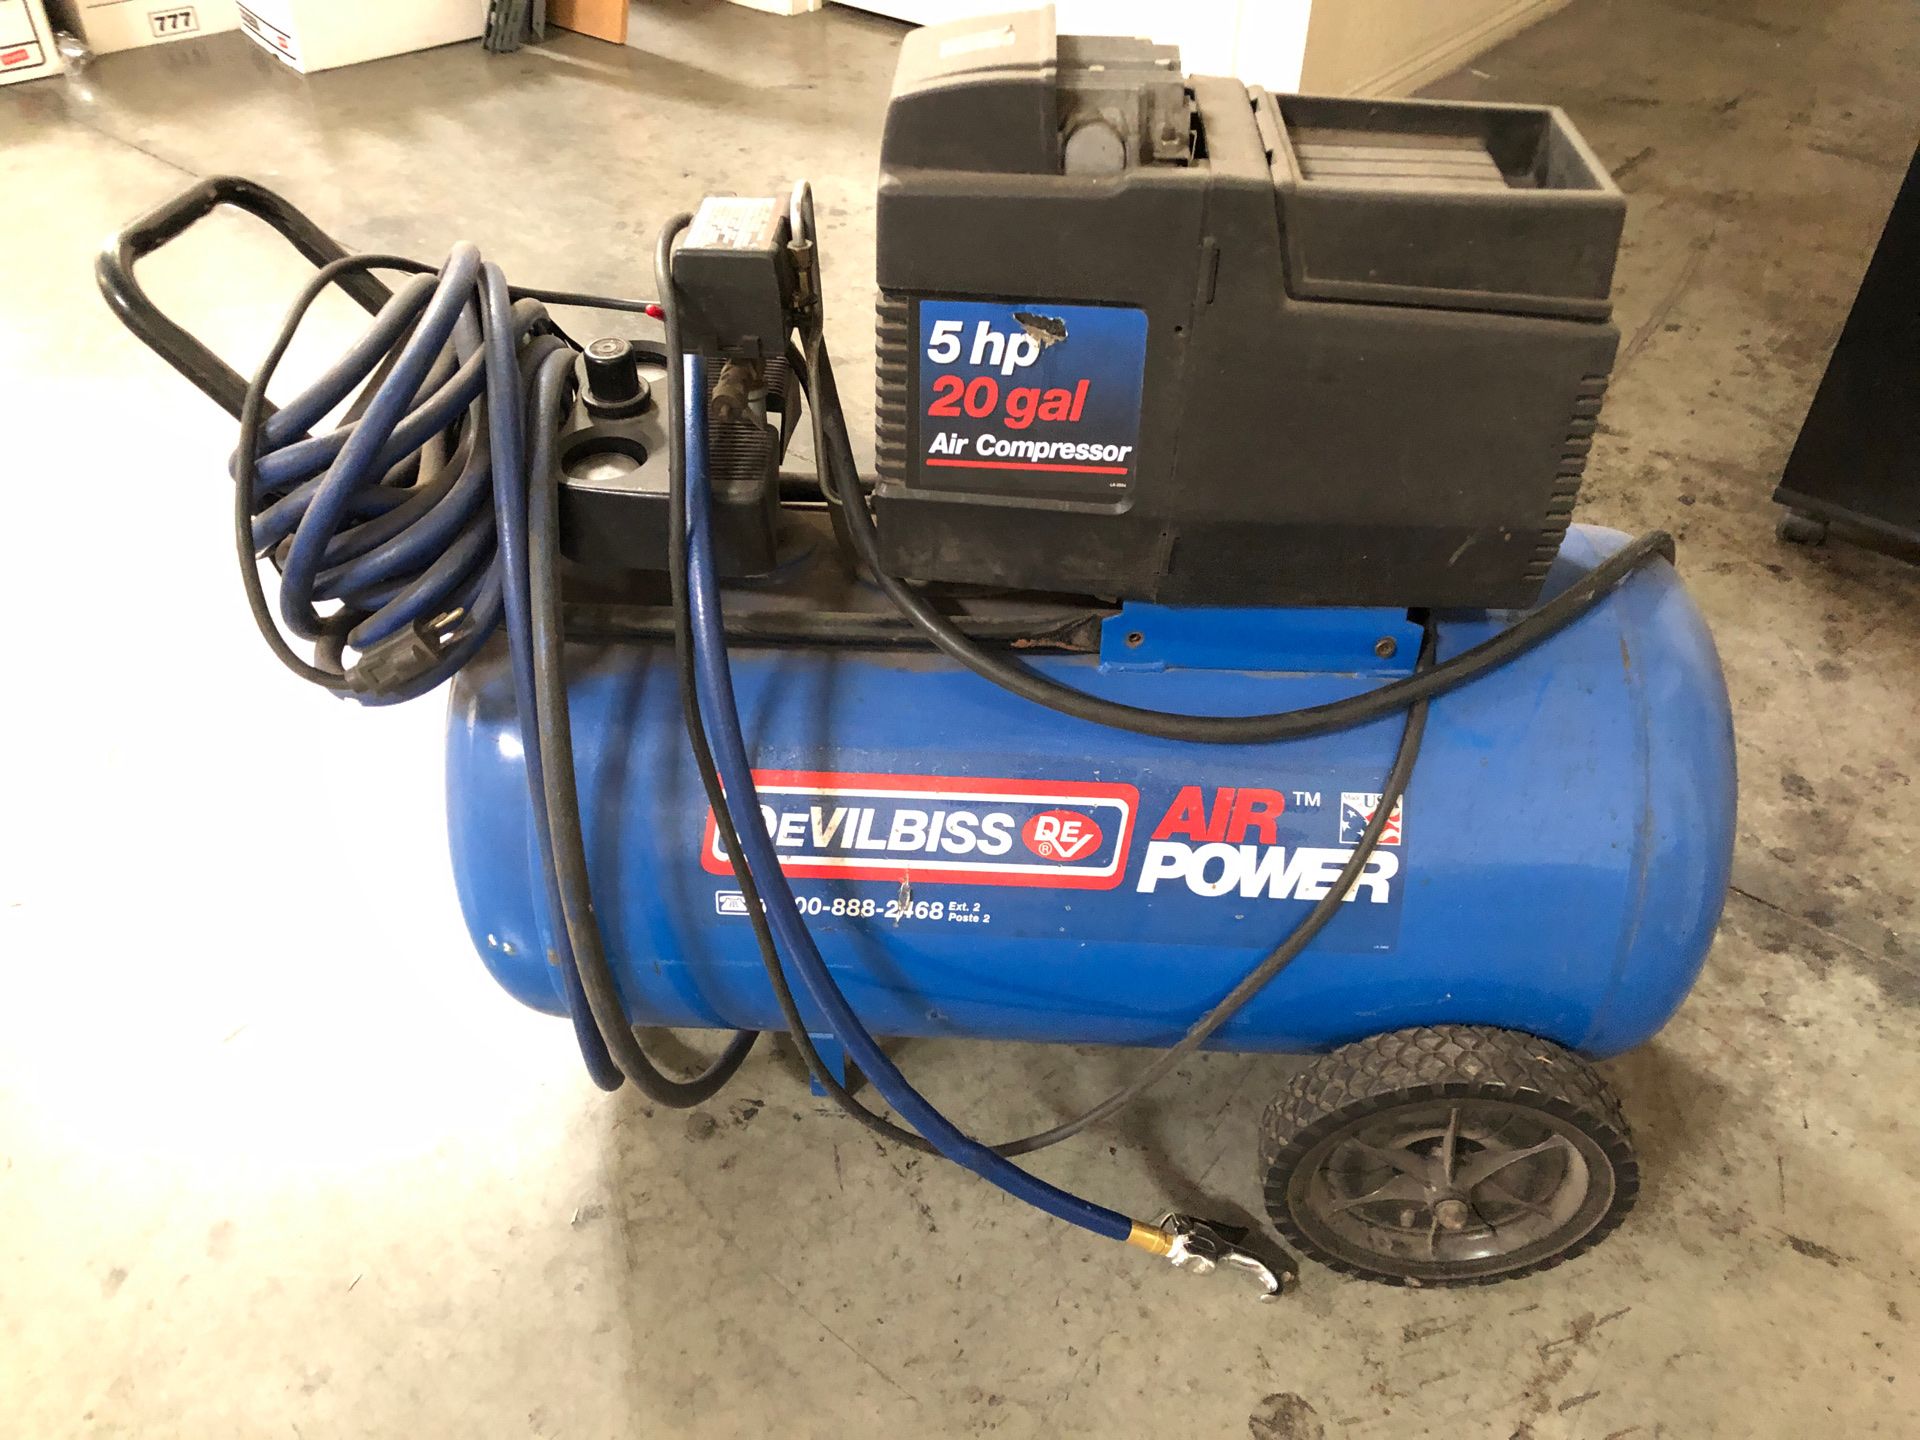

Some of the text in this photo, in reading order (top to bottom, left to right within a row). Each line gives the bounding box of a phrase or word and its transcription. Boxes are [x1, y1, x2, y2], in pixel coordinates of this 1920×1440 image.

[154, 11, 191, 31] 777
[927, 320, 1041, 376] 5 hp
[928, 375, 1090, 429] 20 gal
[928, 432, 1132, 462] Air Compressor
[1151, 786, 1321, 844] AIR TM
[1136, 841, 1399, 903] POWER
[948, 912, 990, 924] Poste 2
[949, 901, 980, 912] Ext. 2
